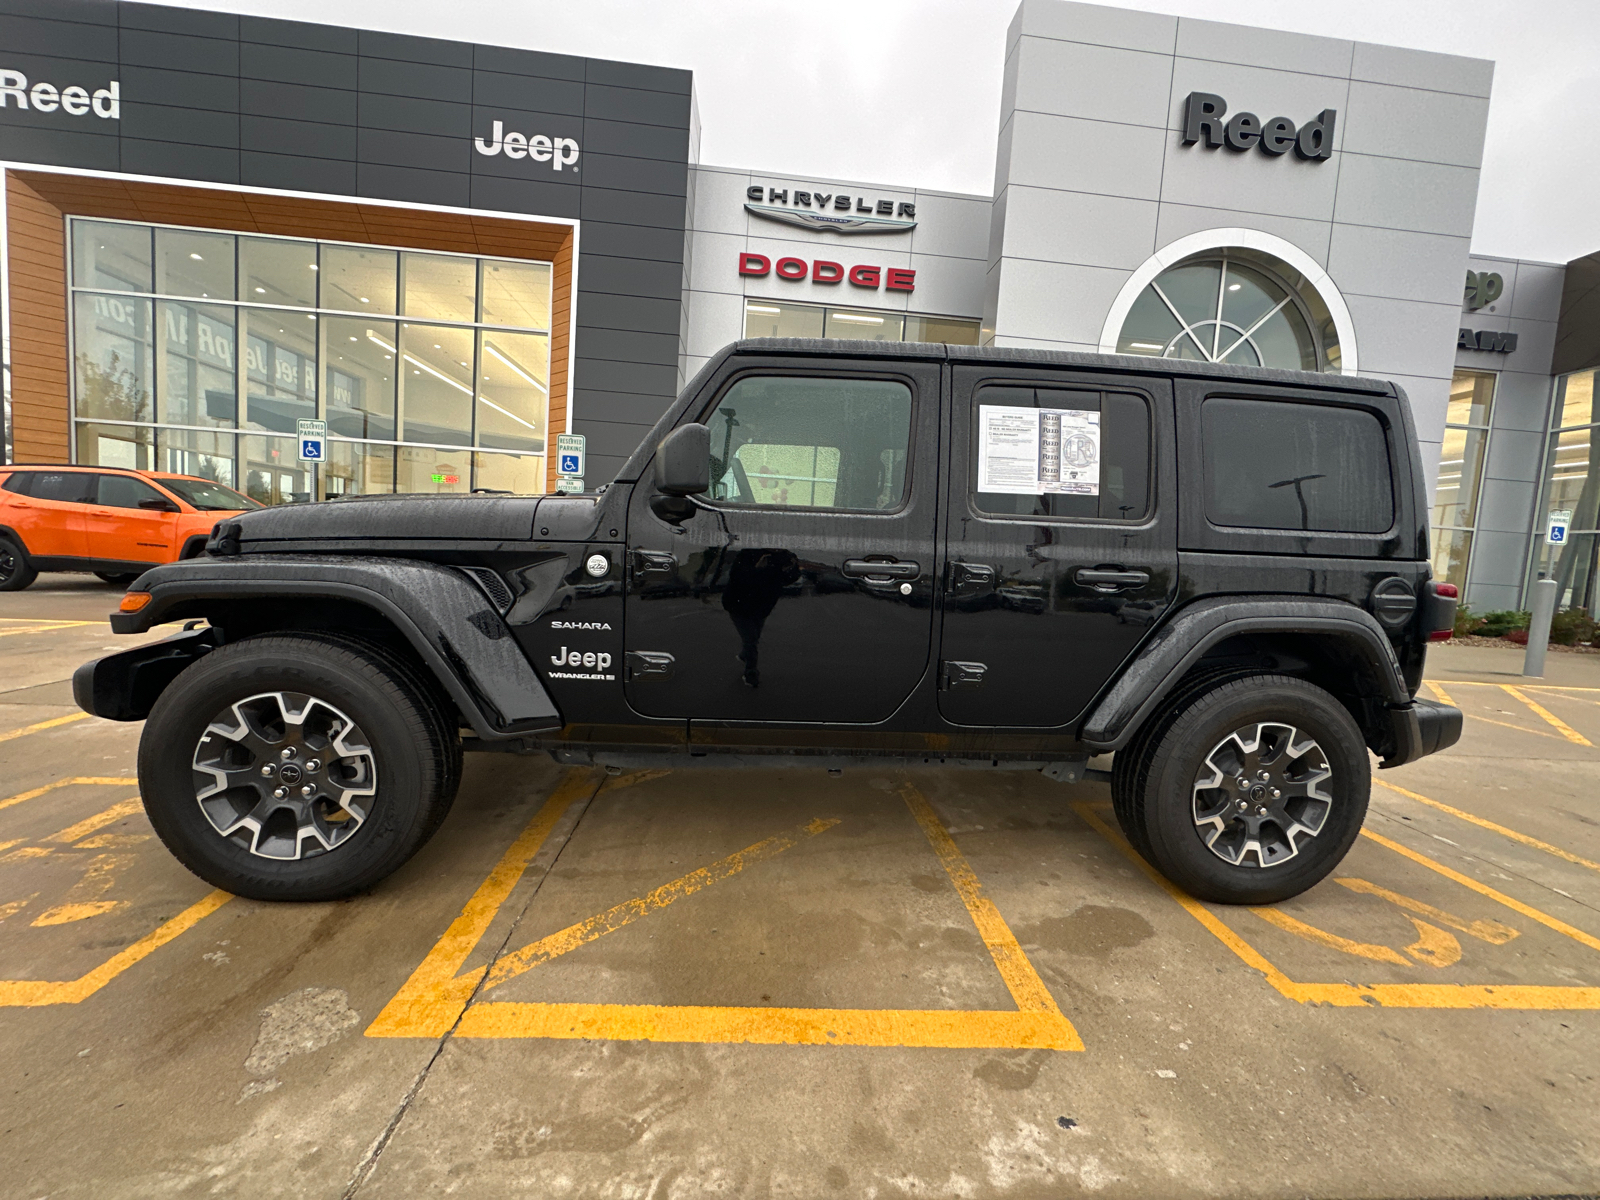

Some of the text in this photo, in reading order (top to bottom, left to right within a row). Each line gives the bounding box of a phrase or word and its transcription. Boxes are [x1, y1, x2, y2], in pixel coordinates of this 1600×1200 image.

[0, 68, 120, 119] Reed
[1182, 91, 1337, 162] Reed
[474, 120, 580, 171] Jeep
[747, 185, 916, 216] CHRYSLER
[739, 252, 916, 292] DODGE
[1457, 328, 1518, 353] AM
[300, 422, 324, 430] RESERVED
[560, 437, 582, 445] RESERVED
[551, 621, 612, 630] SAHARA
[551, 646, 611, 671] Jeep
[548, 672, 605, 680] WRANGLER
